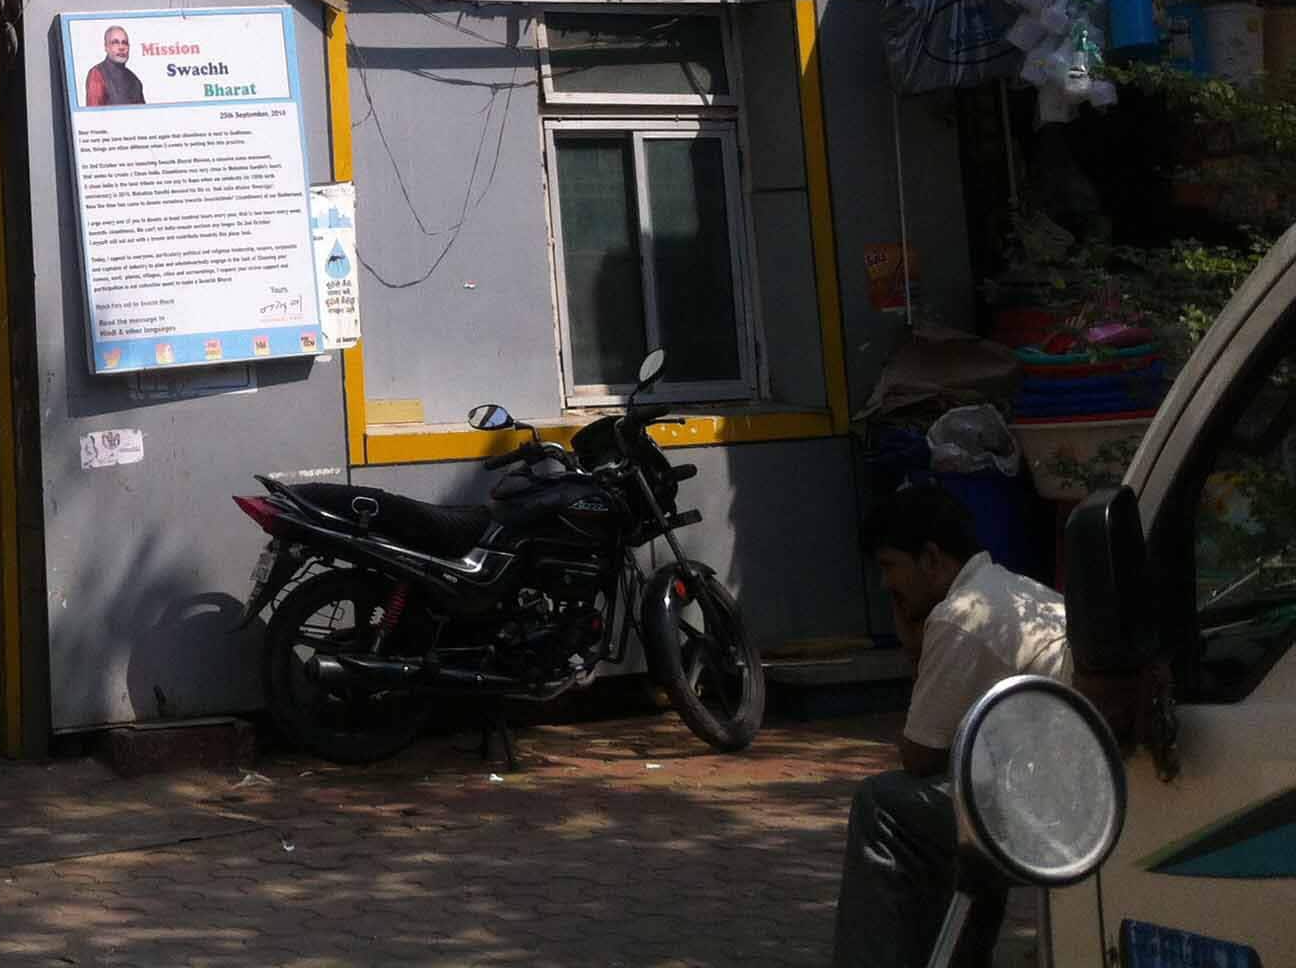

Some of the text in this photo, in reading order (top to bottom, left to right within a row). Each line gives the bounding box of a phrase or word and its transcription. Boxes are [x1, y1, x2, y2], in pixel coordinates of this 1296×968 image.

[141, 42, 201, 57] Mission
[166, 62, 229, 77] Swachh
[203, 83, 257, 98] Bharat
